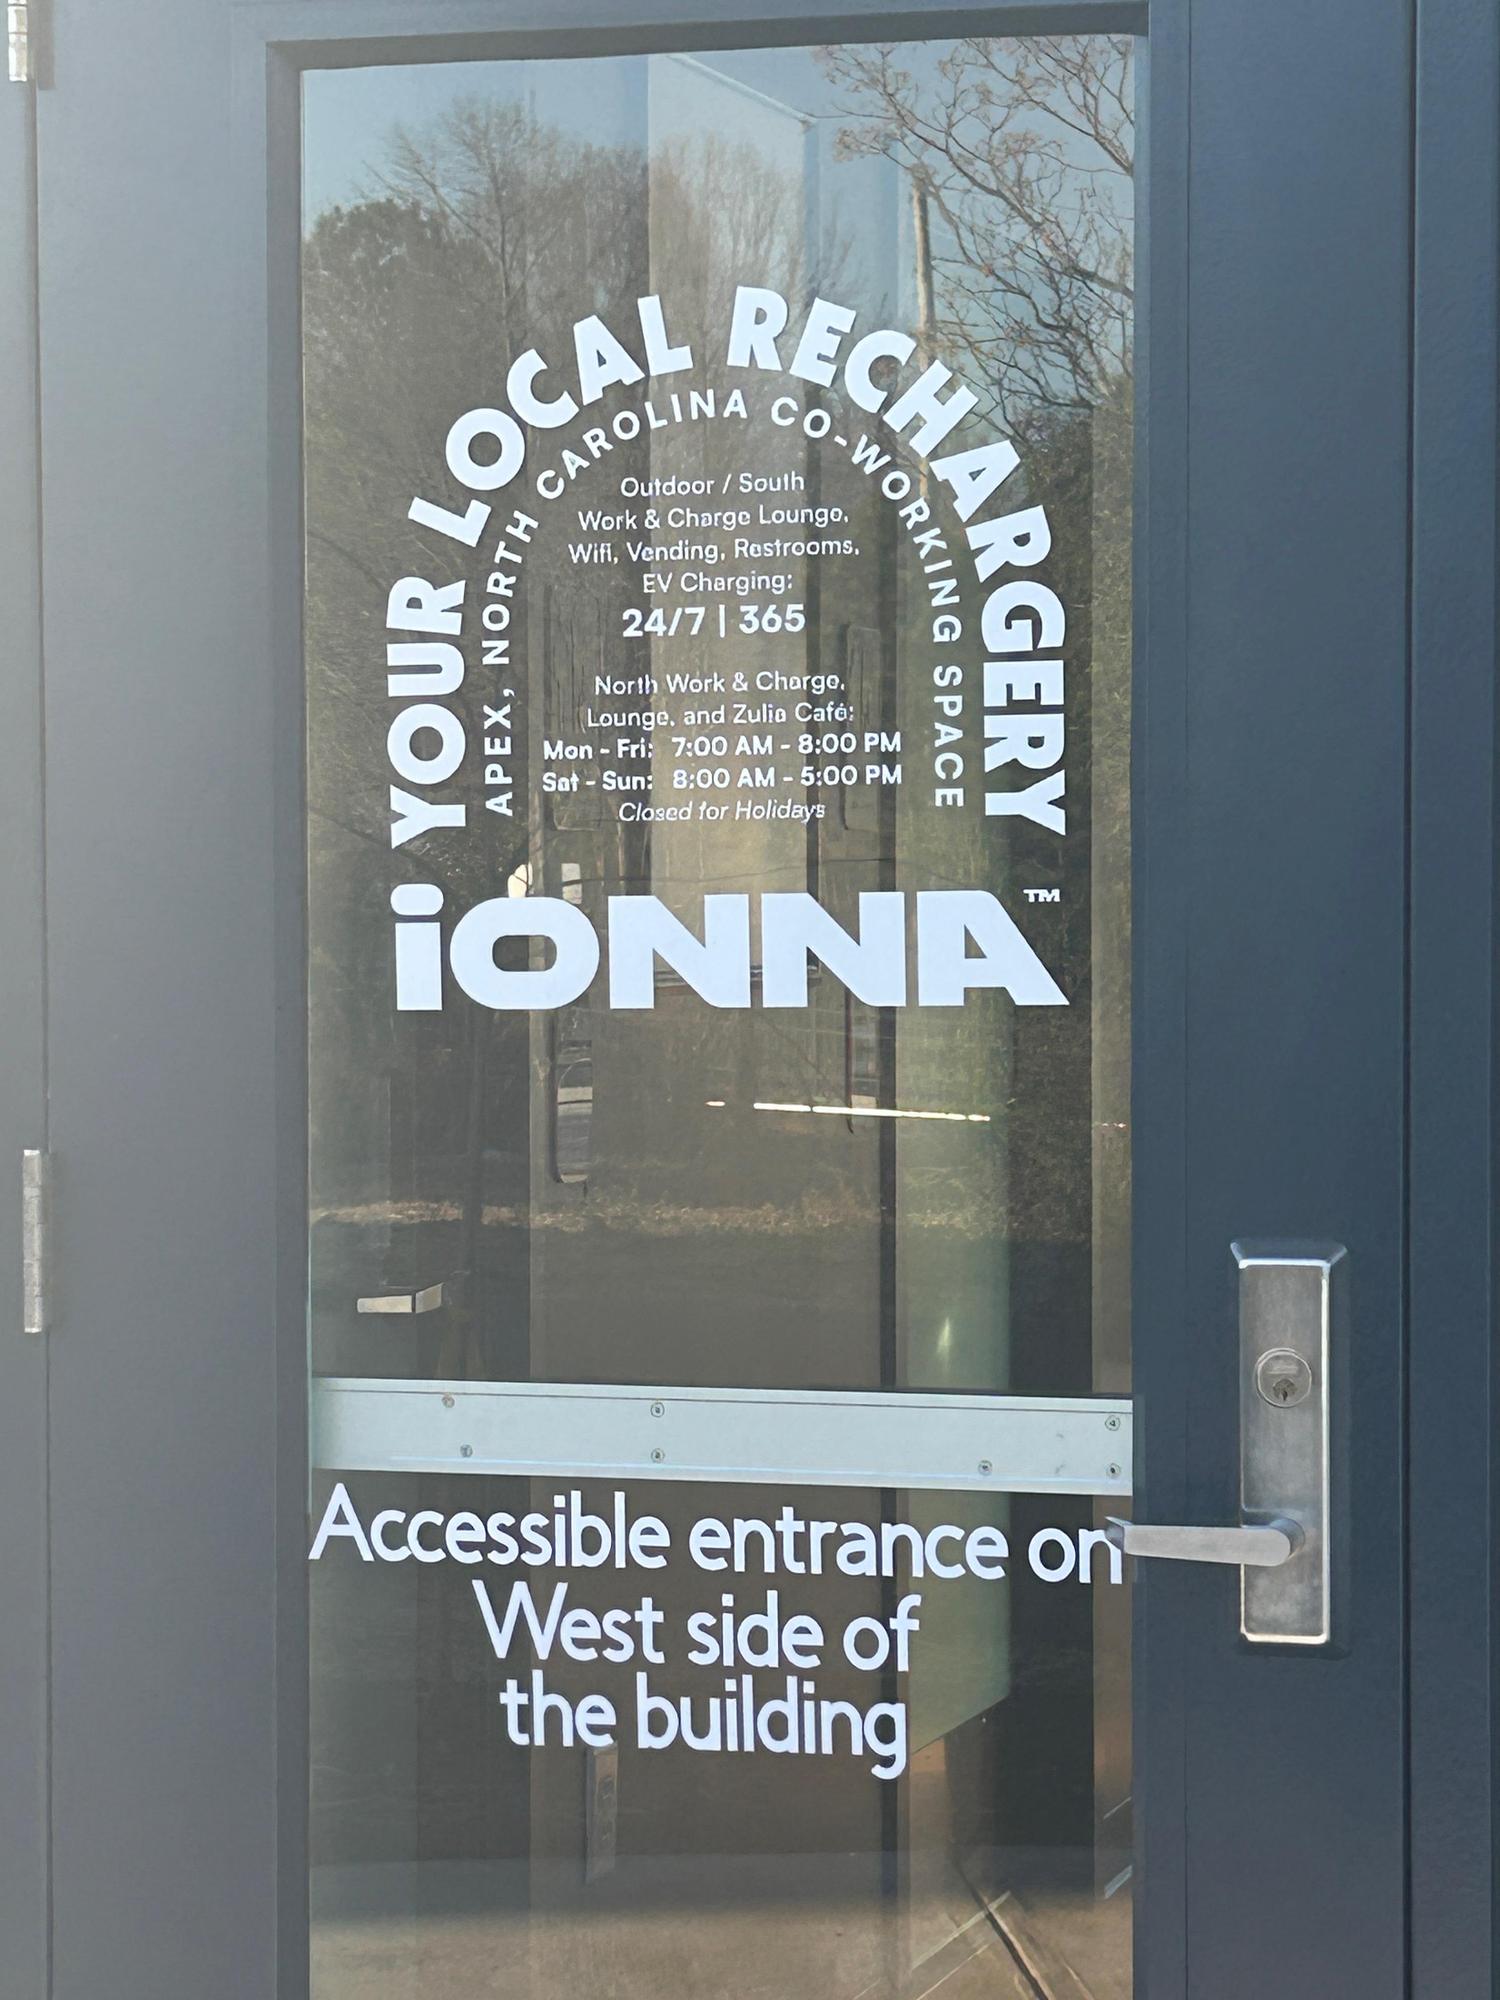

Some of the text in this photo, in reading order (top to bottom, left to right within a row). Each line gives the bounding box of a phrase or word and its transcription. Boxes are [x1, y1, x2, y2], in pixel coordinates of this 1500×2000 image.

[621, 475, 715, 497] Outdoor
[739, 471, 805, 493] South
[578, 504, 849, 531] Work & Charge Lounge,
[568, 538, 860, 565] Wifi, Vending, Restrooms,
[386, 285, 1066, 849] YOUR LOCAL RECHARGERY
[643, 570, 793, 596] EV Charging:
[482, 389, 964, 816] APEX, NORTH CAROLINA CO-WORKING SPACE
[622, 607, 705, 637] 24/7
[739, 604, 805, 634] 365
[595, 670, 845, 695] North Work & Charge,
[684, 704, 725, 725] and
[733, 704, 787, 724] Zulia
[795, 701, 854, 722] Café:
[543, 740, 593, 760] Mon
[617, 737, 654, 759] Fri:
[671, 736, 728, 757] 7:00
[735, 735, 773, 755] AM
[798, 733, 857, 754] 8:00
[864, 732, 901, 752] PM
[542, 772, 579, 792] Sat
[602, 770, 653, 790] Sun:
[673, 768, 730, 789] 8:00
[737, 767, 775, 788] AM
[801, 765, 857, 786] 5:00
[865, 764, 902, 785] PM
[619, 799, 826, 823] Closed for Holidays
[309, 1484, 1122, 1584] Accessible entrance on
[472, 1580, 921, 1672] West side of
[499, 1669, 908, 1779] the building
